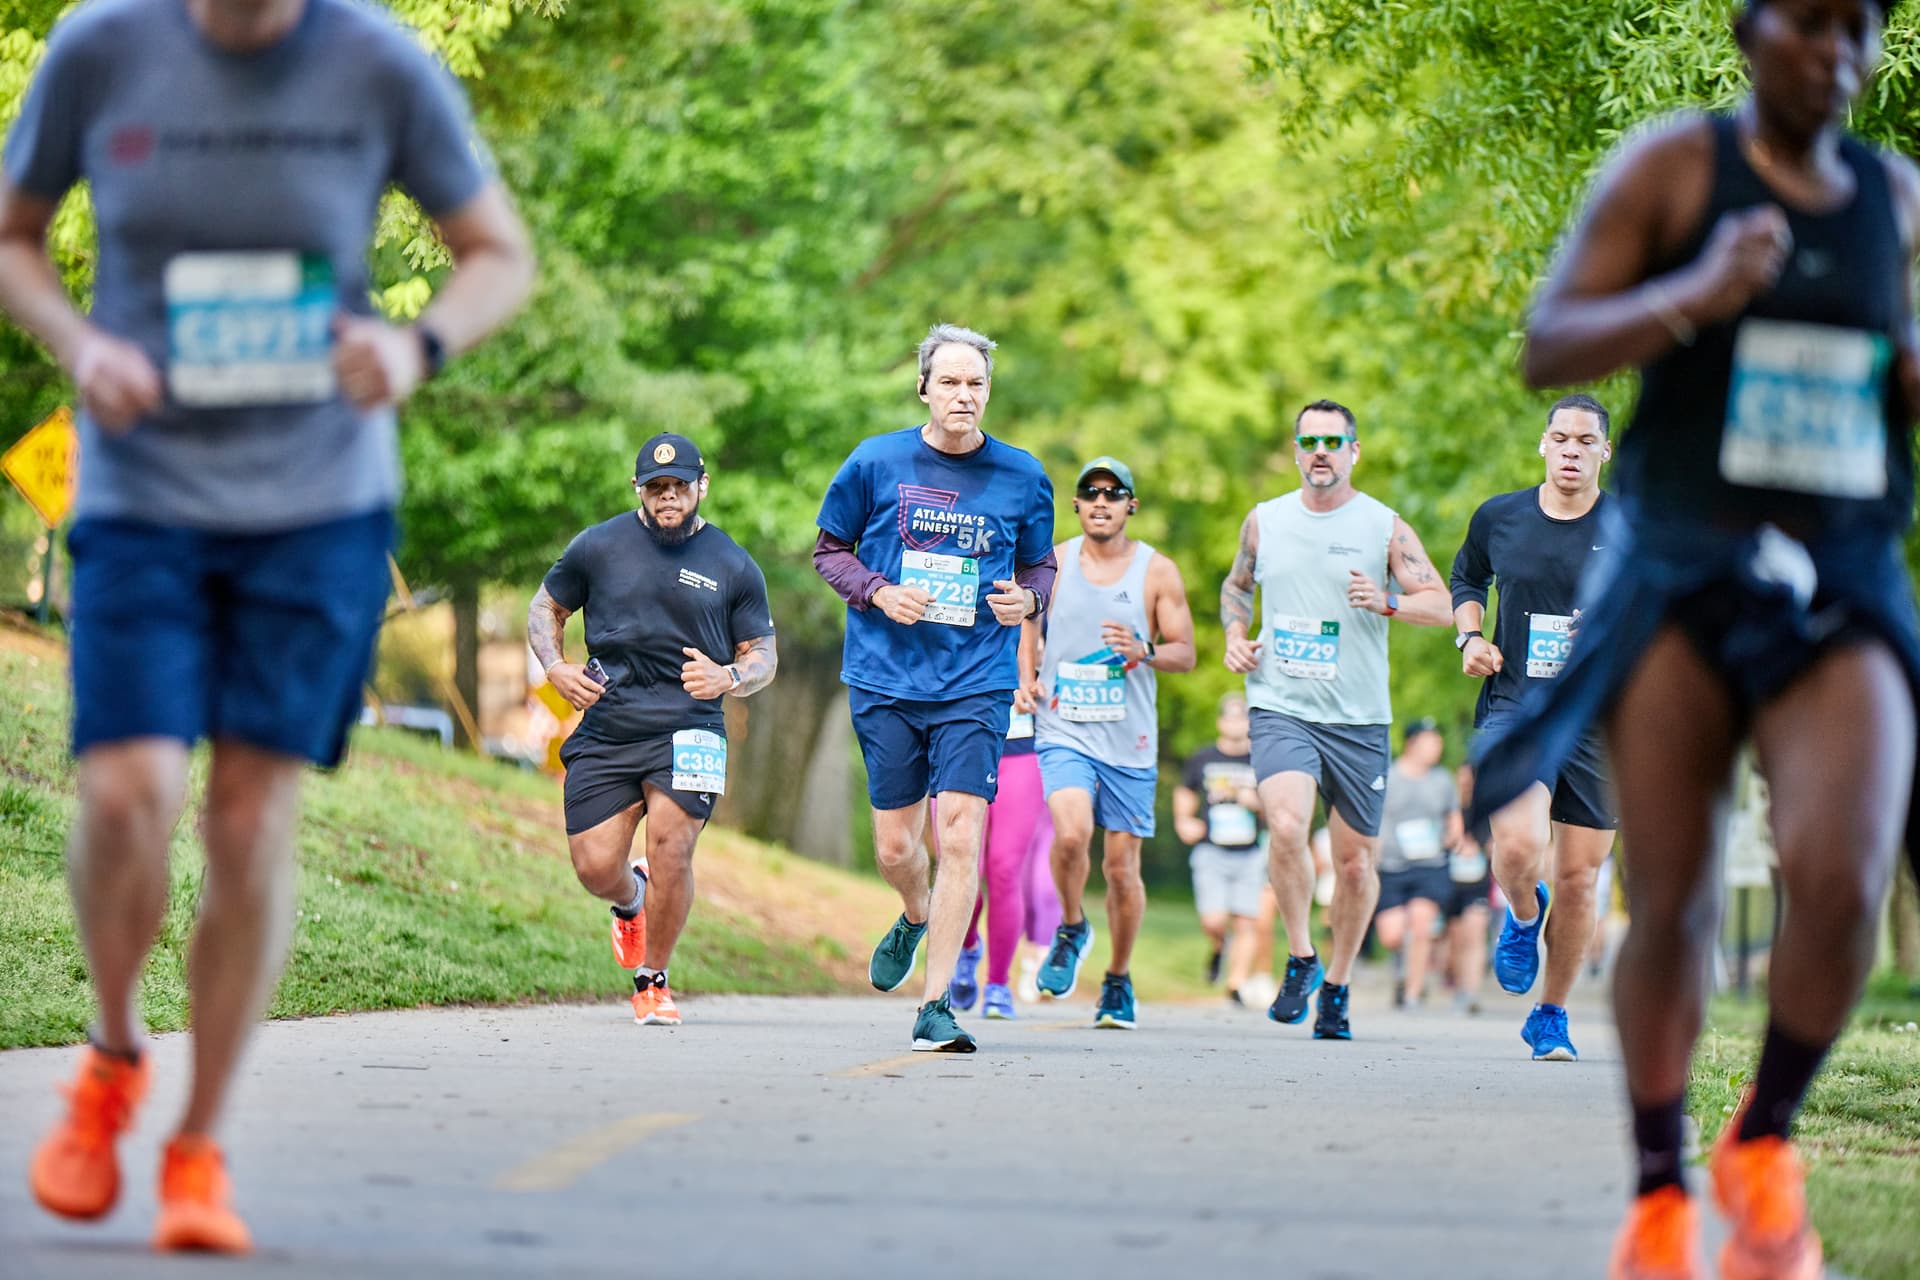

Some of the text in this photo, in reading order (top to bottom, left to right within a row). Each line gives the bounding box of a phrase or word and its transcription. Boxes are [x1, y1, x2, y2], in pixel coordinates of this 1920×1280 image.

[913, 508, 985, 526] ATLANTA'S
[912, 520, 957, 534] FINEST
[957, 526, 995, 553] 5K
[963, 563, 977, 575] 5K
[1322, 625, 1336, 634] 5K
[1275, 637, 1336, 660] C3729
[1060, 685, 1123, 704] A3310
